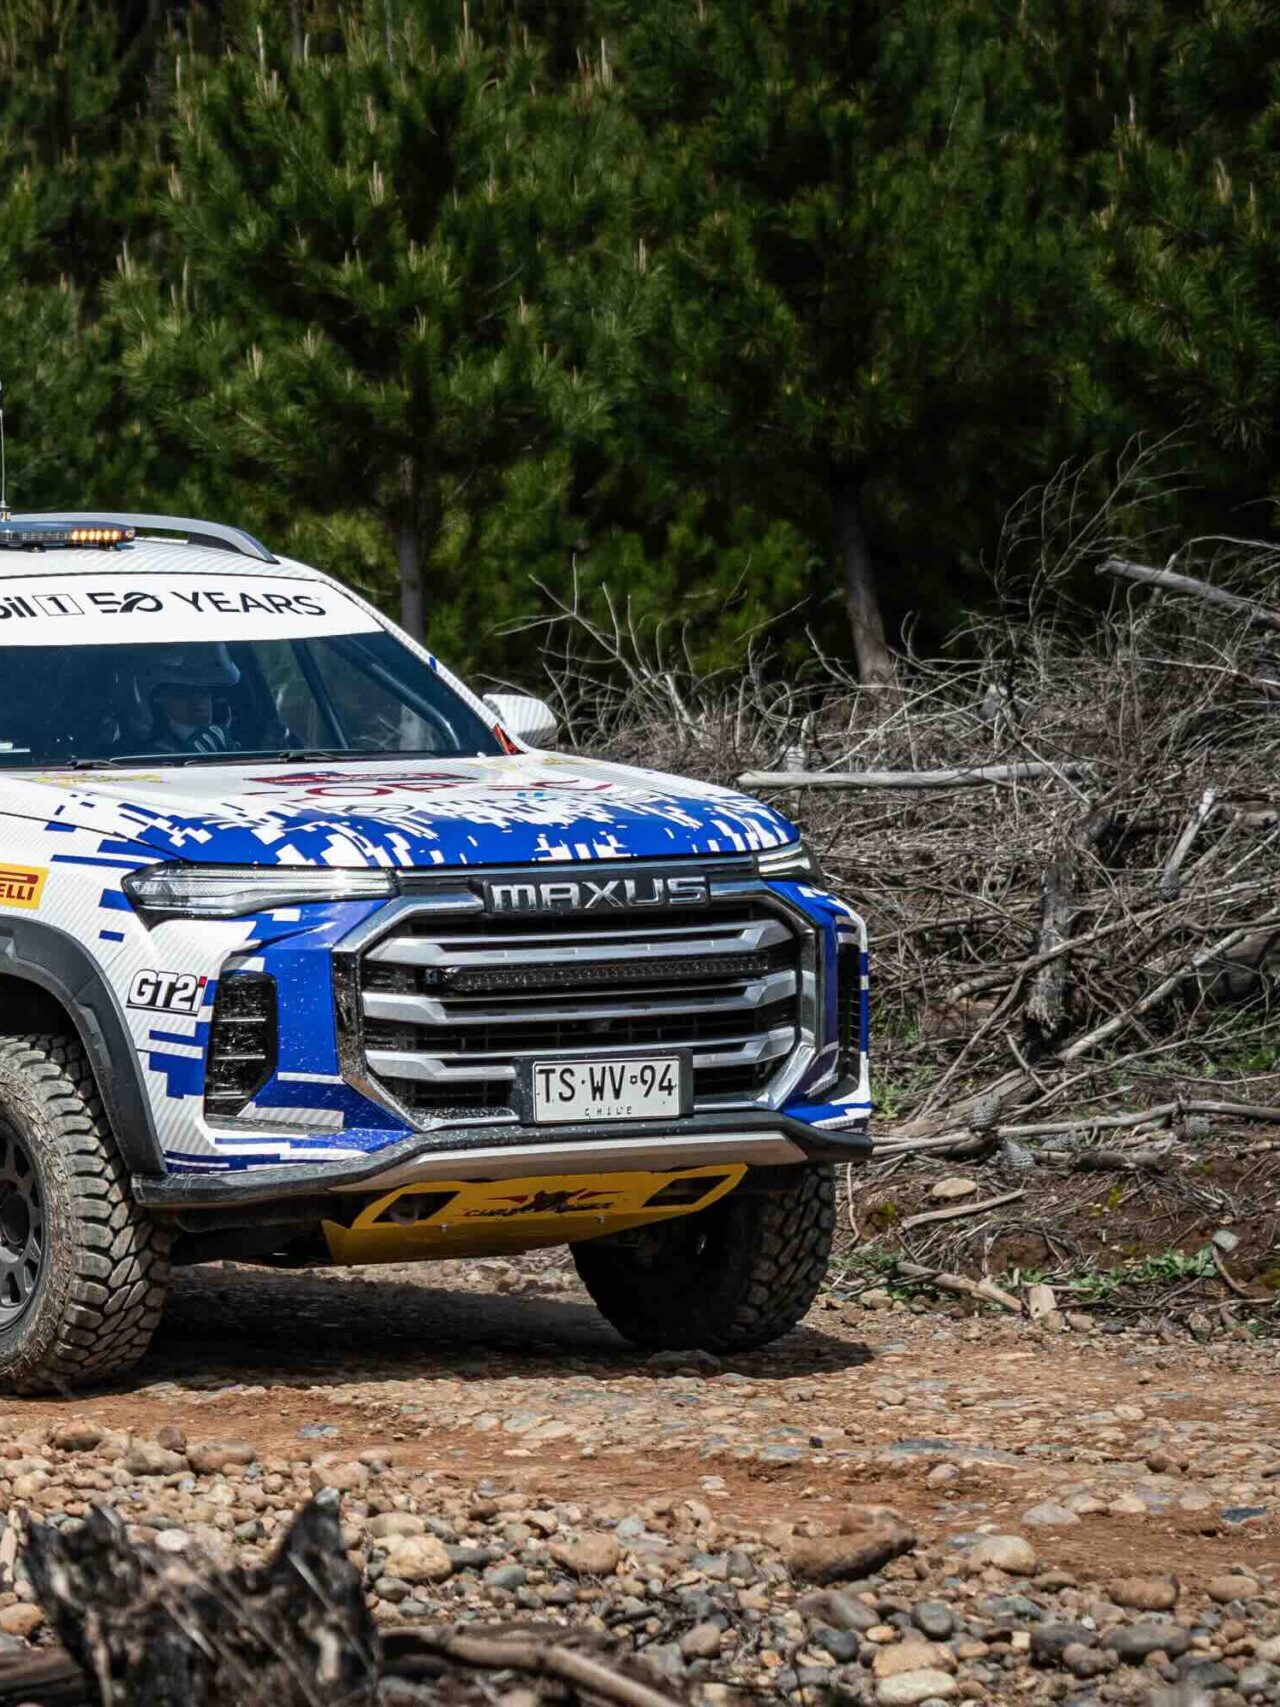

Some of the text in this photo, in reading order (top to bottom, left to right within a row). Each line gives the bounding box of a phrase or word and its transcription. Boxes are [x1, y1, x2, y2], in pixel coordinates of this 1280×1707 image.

[86, 591, 164, 614] 50
[170, 591, 327, 616] YEARS
[491, 876, 710, 912] MAXUS
[128, 968, 207, 1013] GT2i
[584, 1105, 632, 1117] CHILE
